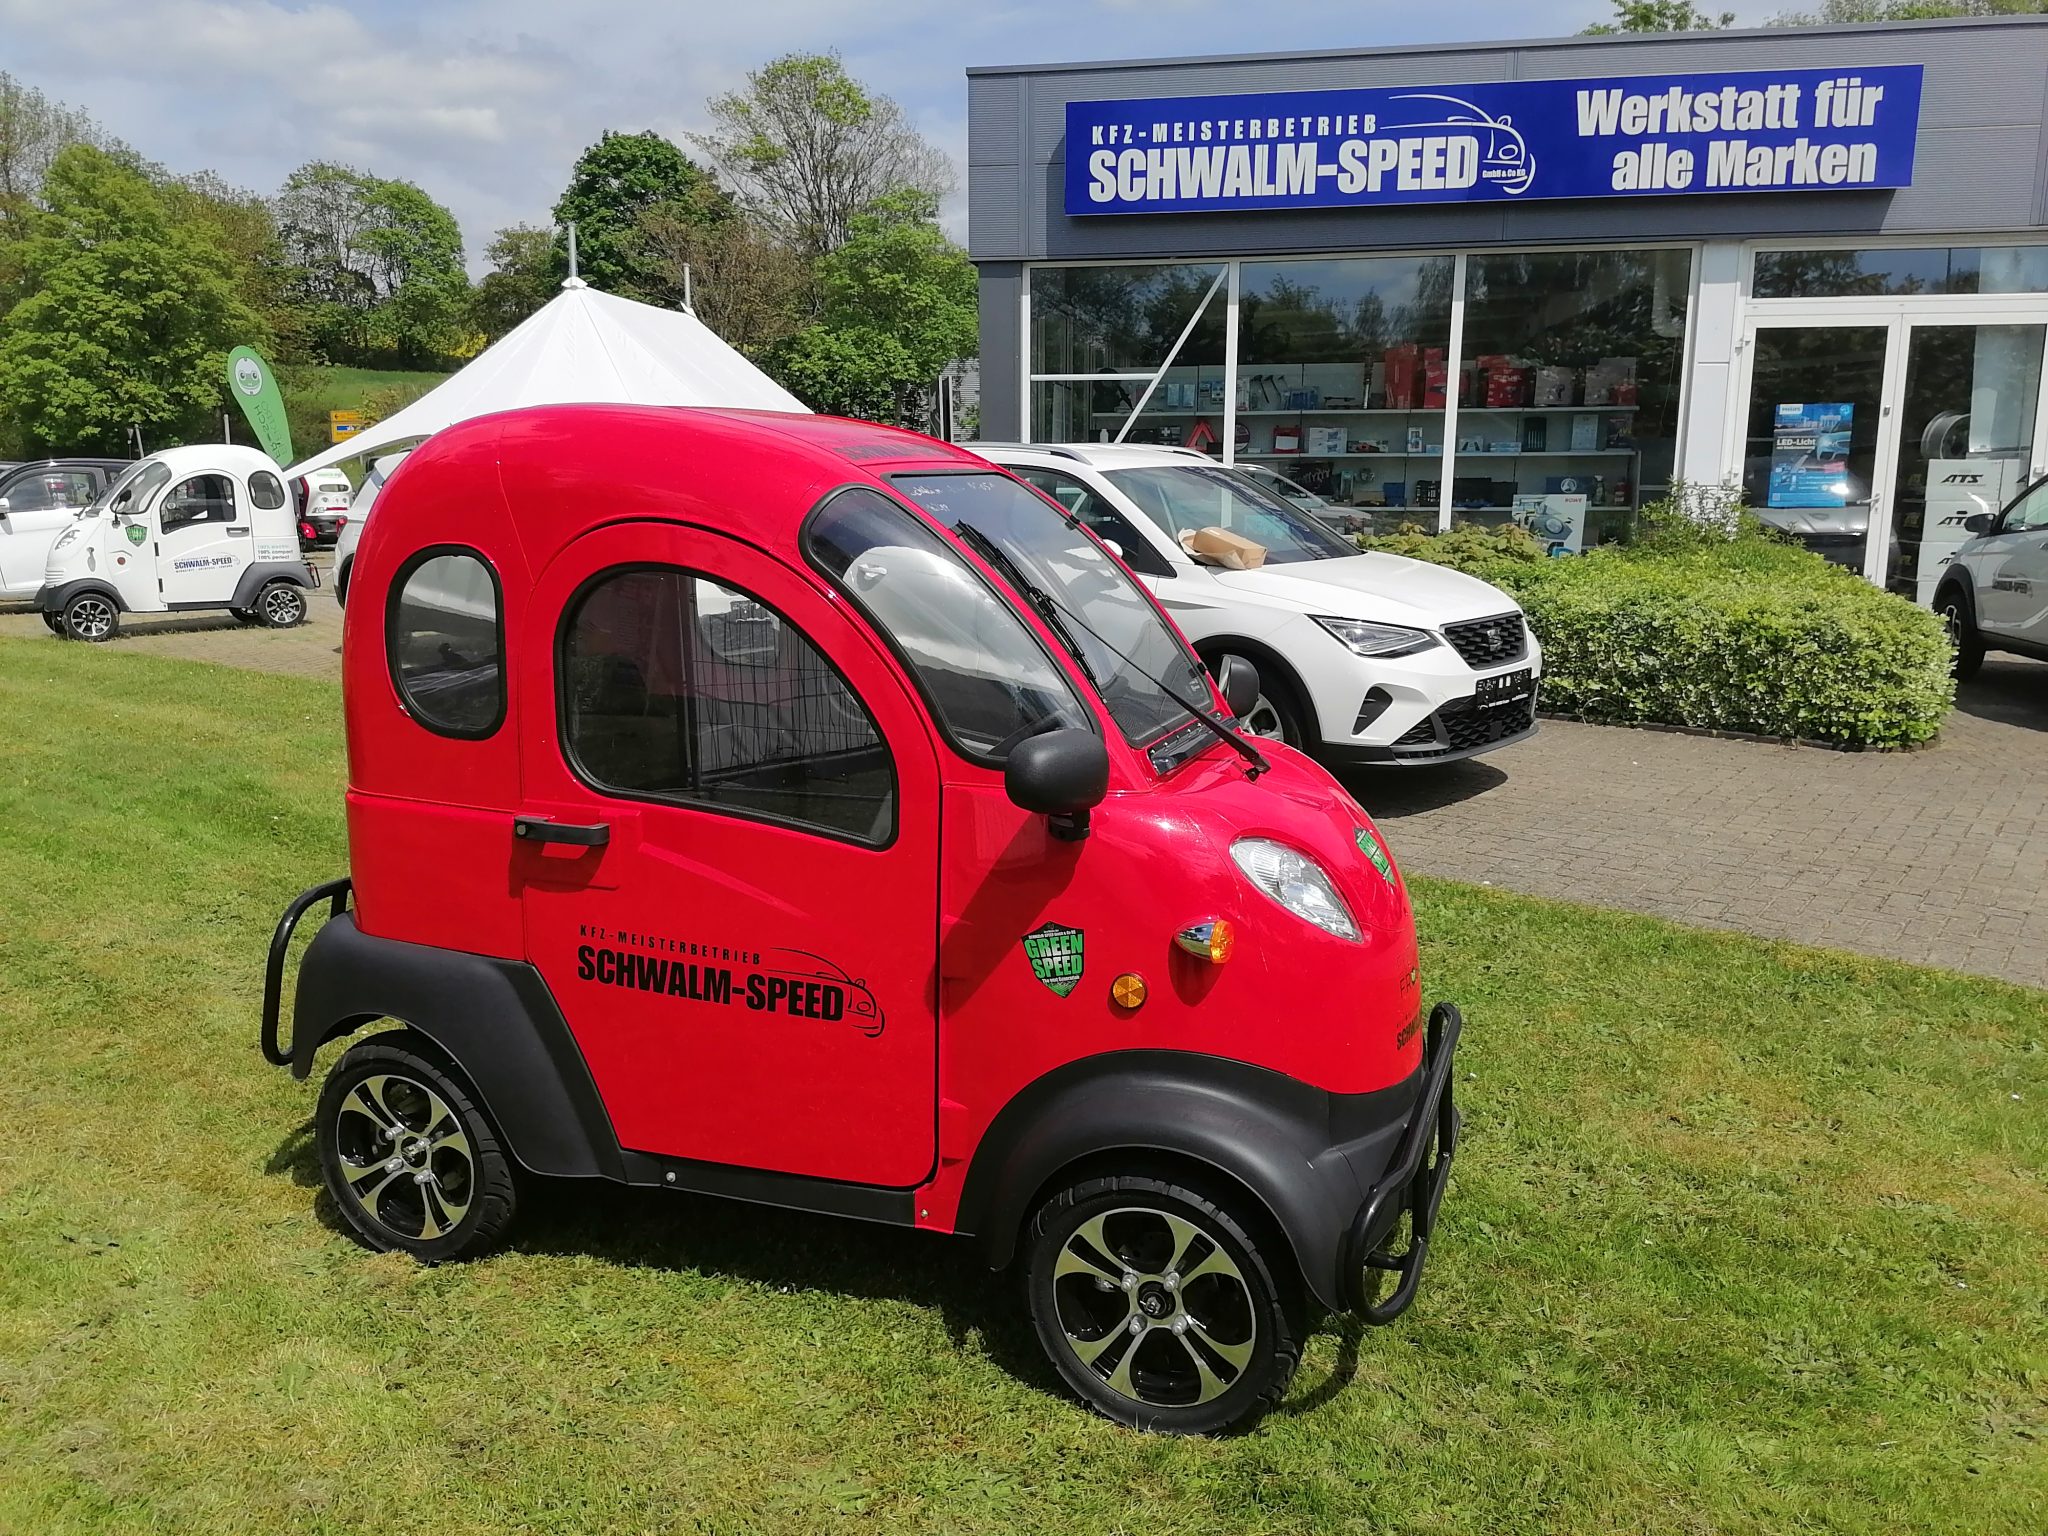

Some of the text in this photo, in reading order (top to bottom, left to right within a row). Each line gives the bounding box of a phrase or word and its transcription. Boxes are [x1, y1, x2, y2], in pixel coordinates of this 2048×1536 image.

[1576, 77, 1884, 137] Werkstatt für
[1092, 114, 1377, 145] KFZ-MEISTERBETRIEB
[1088, 134, 1479, 203] SCHWALM-SPEED
[1611, 137, 1878, 191] alle Marken
[1776, 438, 1816, 446] LED-Licht
[1940, 474, 1985, 484] ATS
[1937, 516, 1968, 526] AT
[174, 556, 232, 570] SCHWALM-SPEED
[580, 924, 760, 965] KFZ-MEISTERBETRIEB
[1024, 933, 1083, 958] GREEN
[1031, 954, 1083, 979] SPEED
[577, 945, 844, 1022] SCHWALM-SPEED
